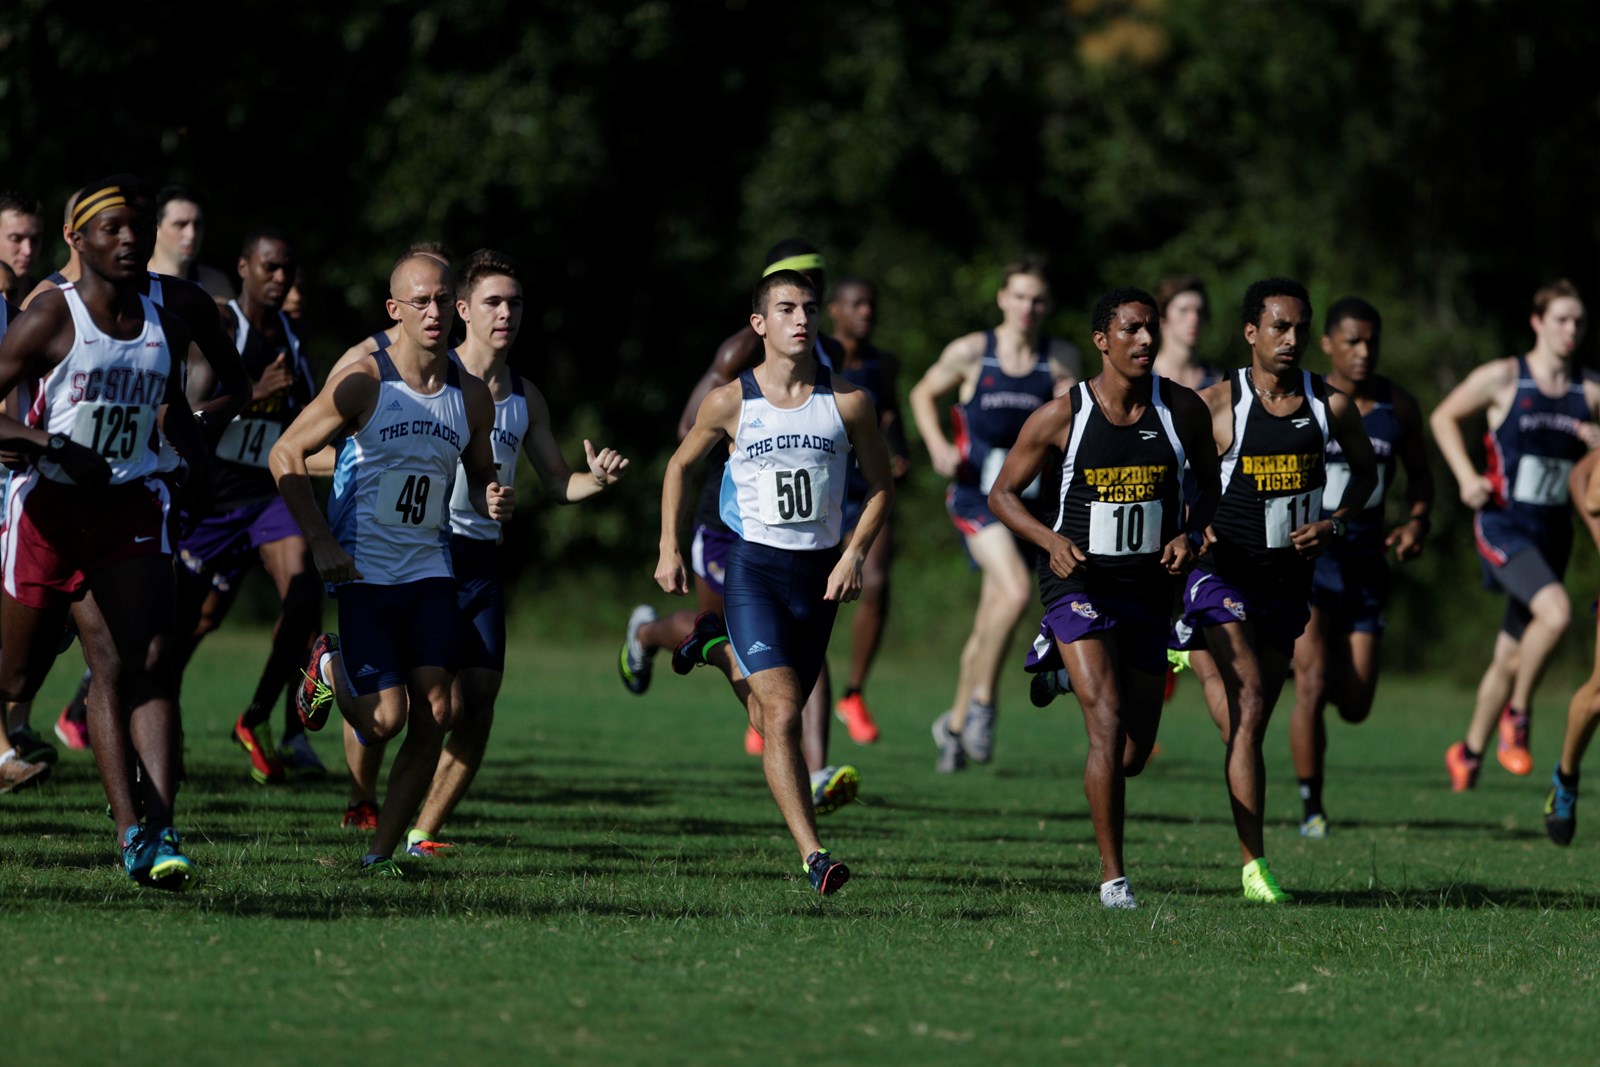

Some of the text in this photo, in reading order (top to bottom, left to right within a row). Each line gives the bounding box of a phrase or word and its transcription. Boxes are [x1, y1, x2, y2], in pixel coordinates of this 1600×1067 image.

[92, 406, 139, 459] 125
[238, 423, 267, 462] 14
[380, 420, 461, 451] THE CITADEL
[747, 434, 836, 459] THE CITADEL
[776, 468, 813, 520] 50
[1083, 465, 1168, 486] BENEDICT
[1097, 484, 1155, 502] TIGERS
[1255, 472, 1308, 491] TIGERS
[395, 475, 431, 525] 49
[1287, 494, 1311, 534] 11
[1113, 503, 1144, 552] 10
